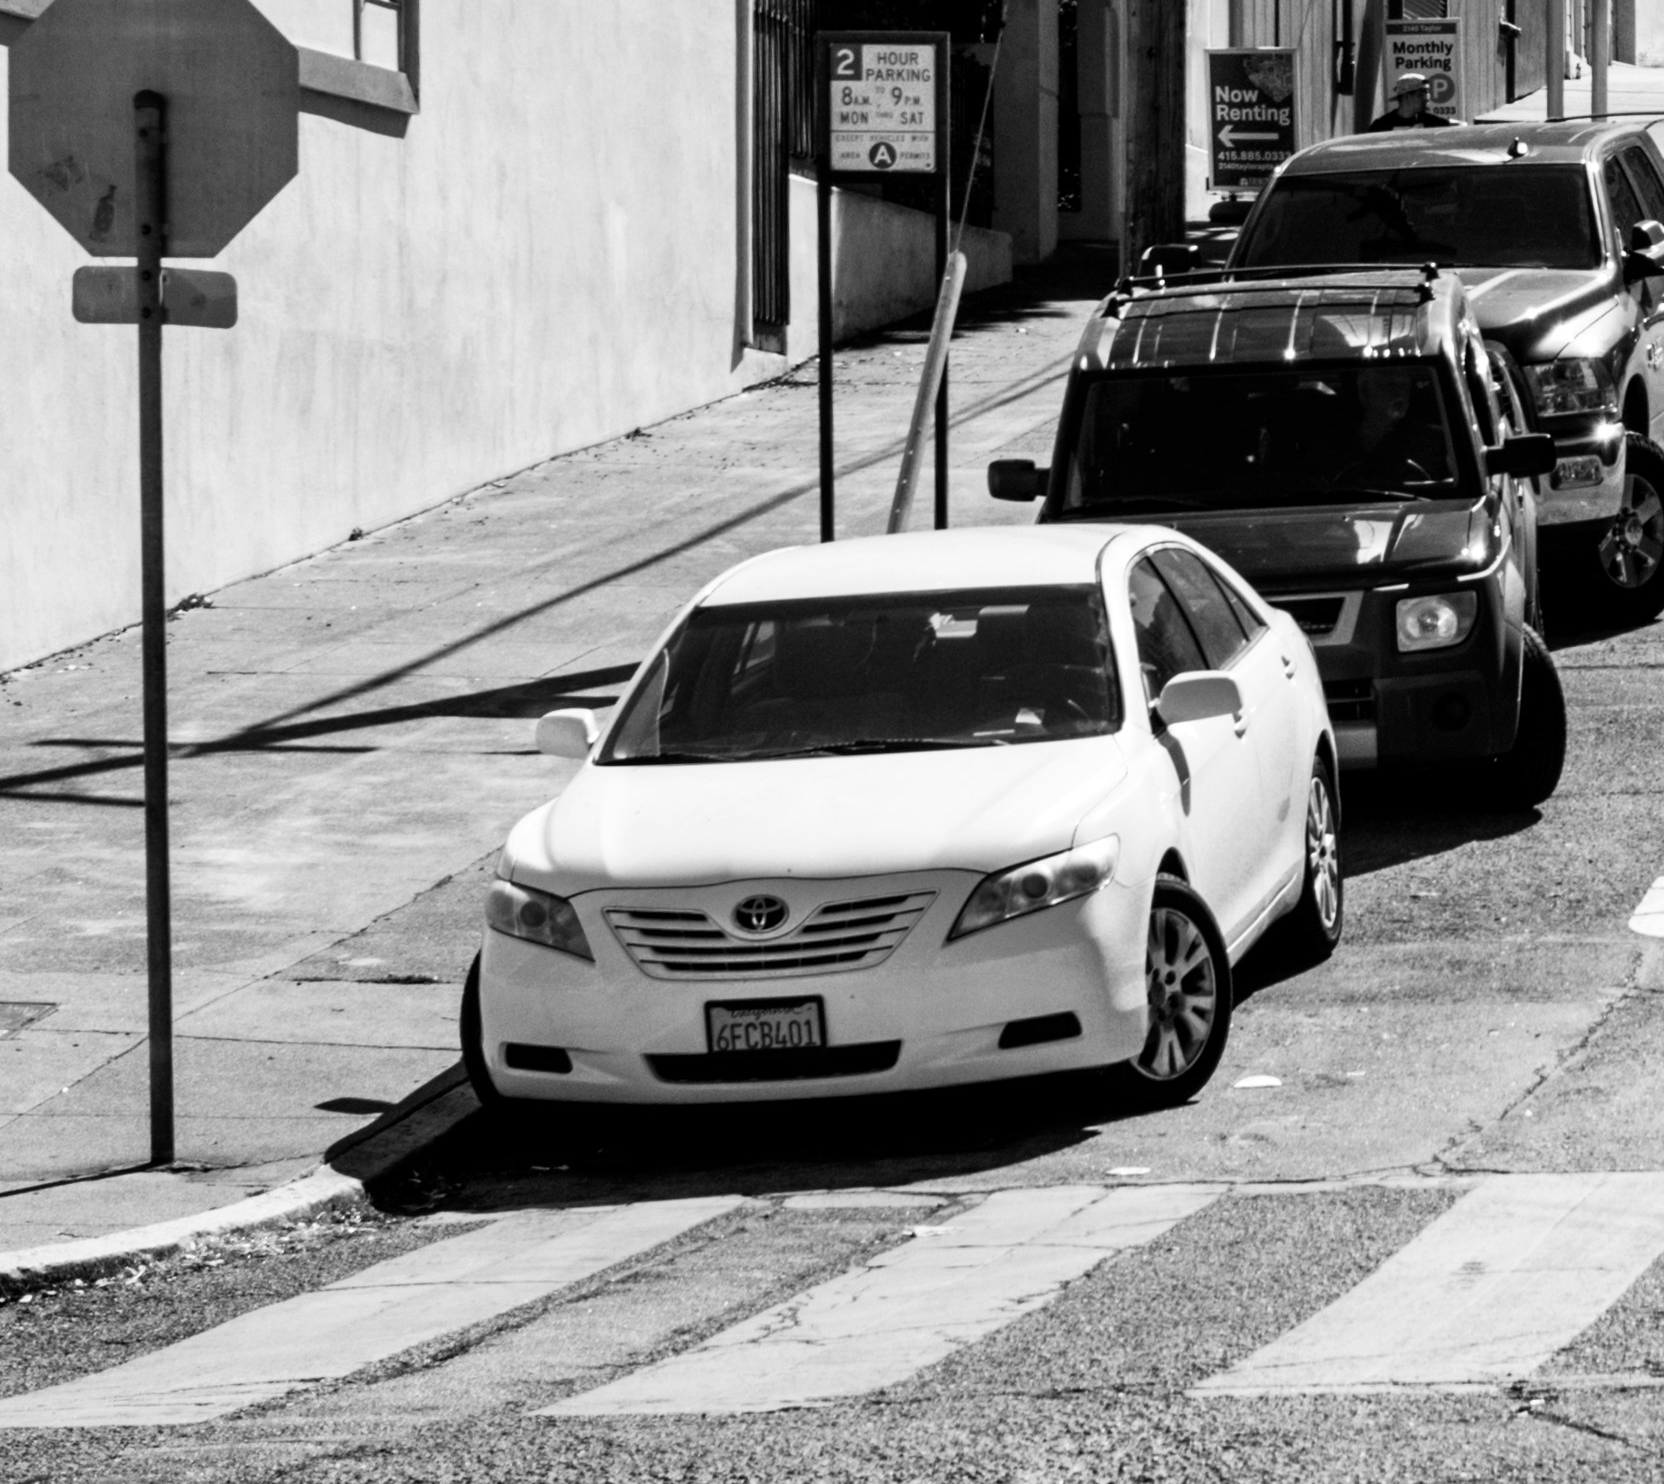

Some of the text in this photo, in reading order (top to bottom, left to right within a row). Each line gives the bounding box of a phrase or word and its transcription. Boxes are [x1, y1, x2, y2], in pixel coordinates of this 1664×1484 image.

[1393, 41, 1453, 56] Monthly
[837, 48, 919, 75] 2 HOUR
[1395, 56, 1452, 72] Parking
[865, 69, 932, 83] PARKING
[1215, 85, 1258, 103] Now
[1433, 79, 1448, 100] P
[840, 111, 869, 124] MON
[900, 111, 924, 125] SAT
[1216, 103, 1290, 126] Renting
[873, 144, 892, 165] A
[716, 1019, 817, 1051] 6FCB401
